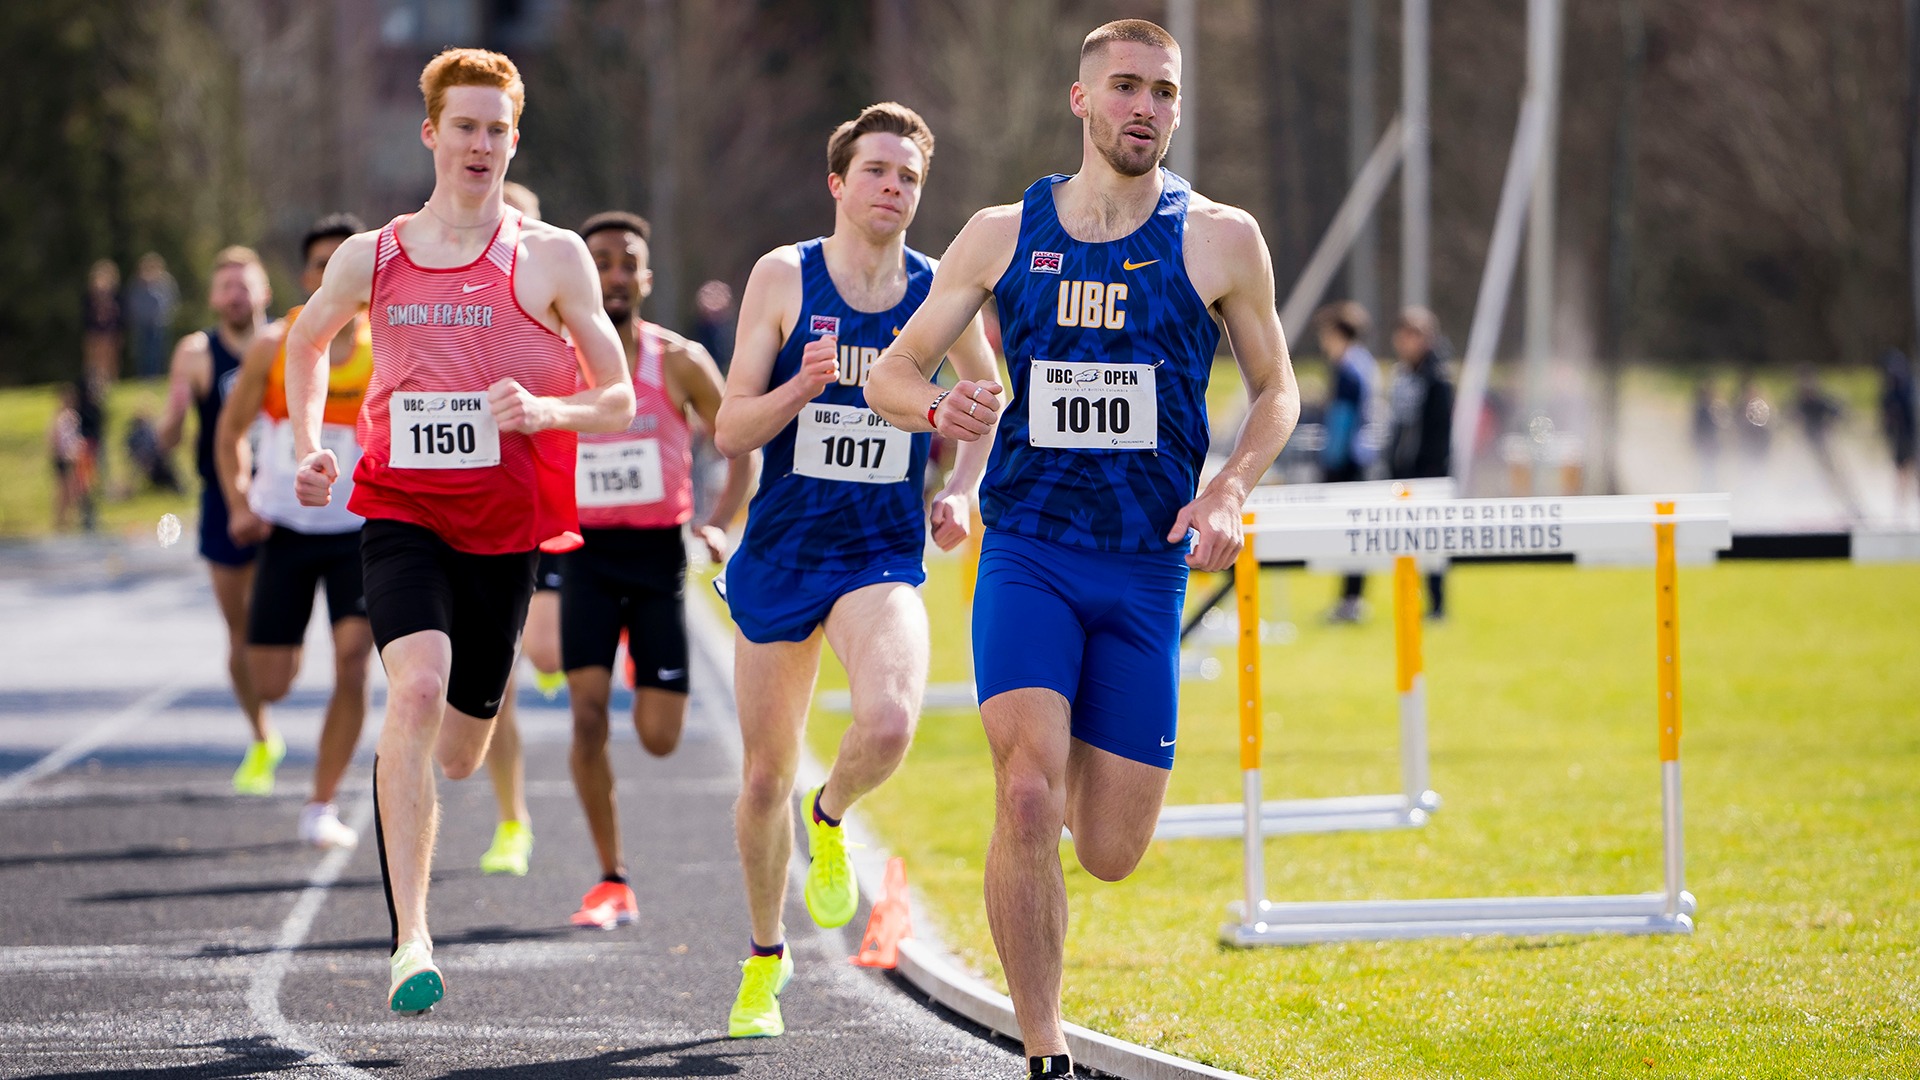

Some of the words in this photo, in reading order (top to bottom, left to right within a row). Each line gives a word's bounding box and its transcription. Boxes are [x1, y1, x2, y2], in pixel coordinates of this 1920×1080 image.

[1034, 257, 1059, 267] CCC
[386, 303, 428, 327] SIMON
[433, 303, 494, 328] FRASER
[1057, 280, 1128, 330] UBC
[839, 345, 889, 388] UB
[1046, 368, 1073, 384] UBC
[1104, 370, 1138, 385] OPEN
[403, 398, 424, 411] UBC
[451, 398, 481, 411] OPEN
[815, 410, 840, 424] UBC
[1052, 396, 1130, 434] 1010
[409, 423, 475, 454] 1150
[821, 435, 886, 468] 1017
[1345, 524, 1562, 552] THUNDERBIRDS
